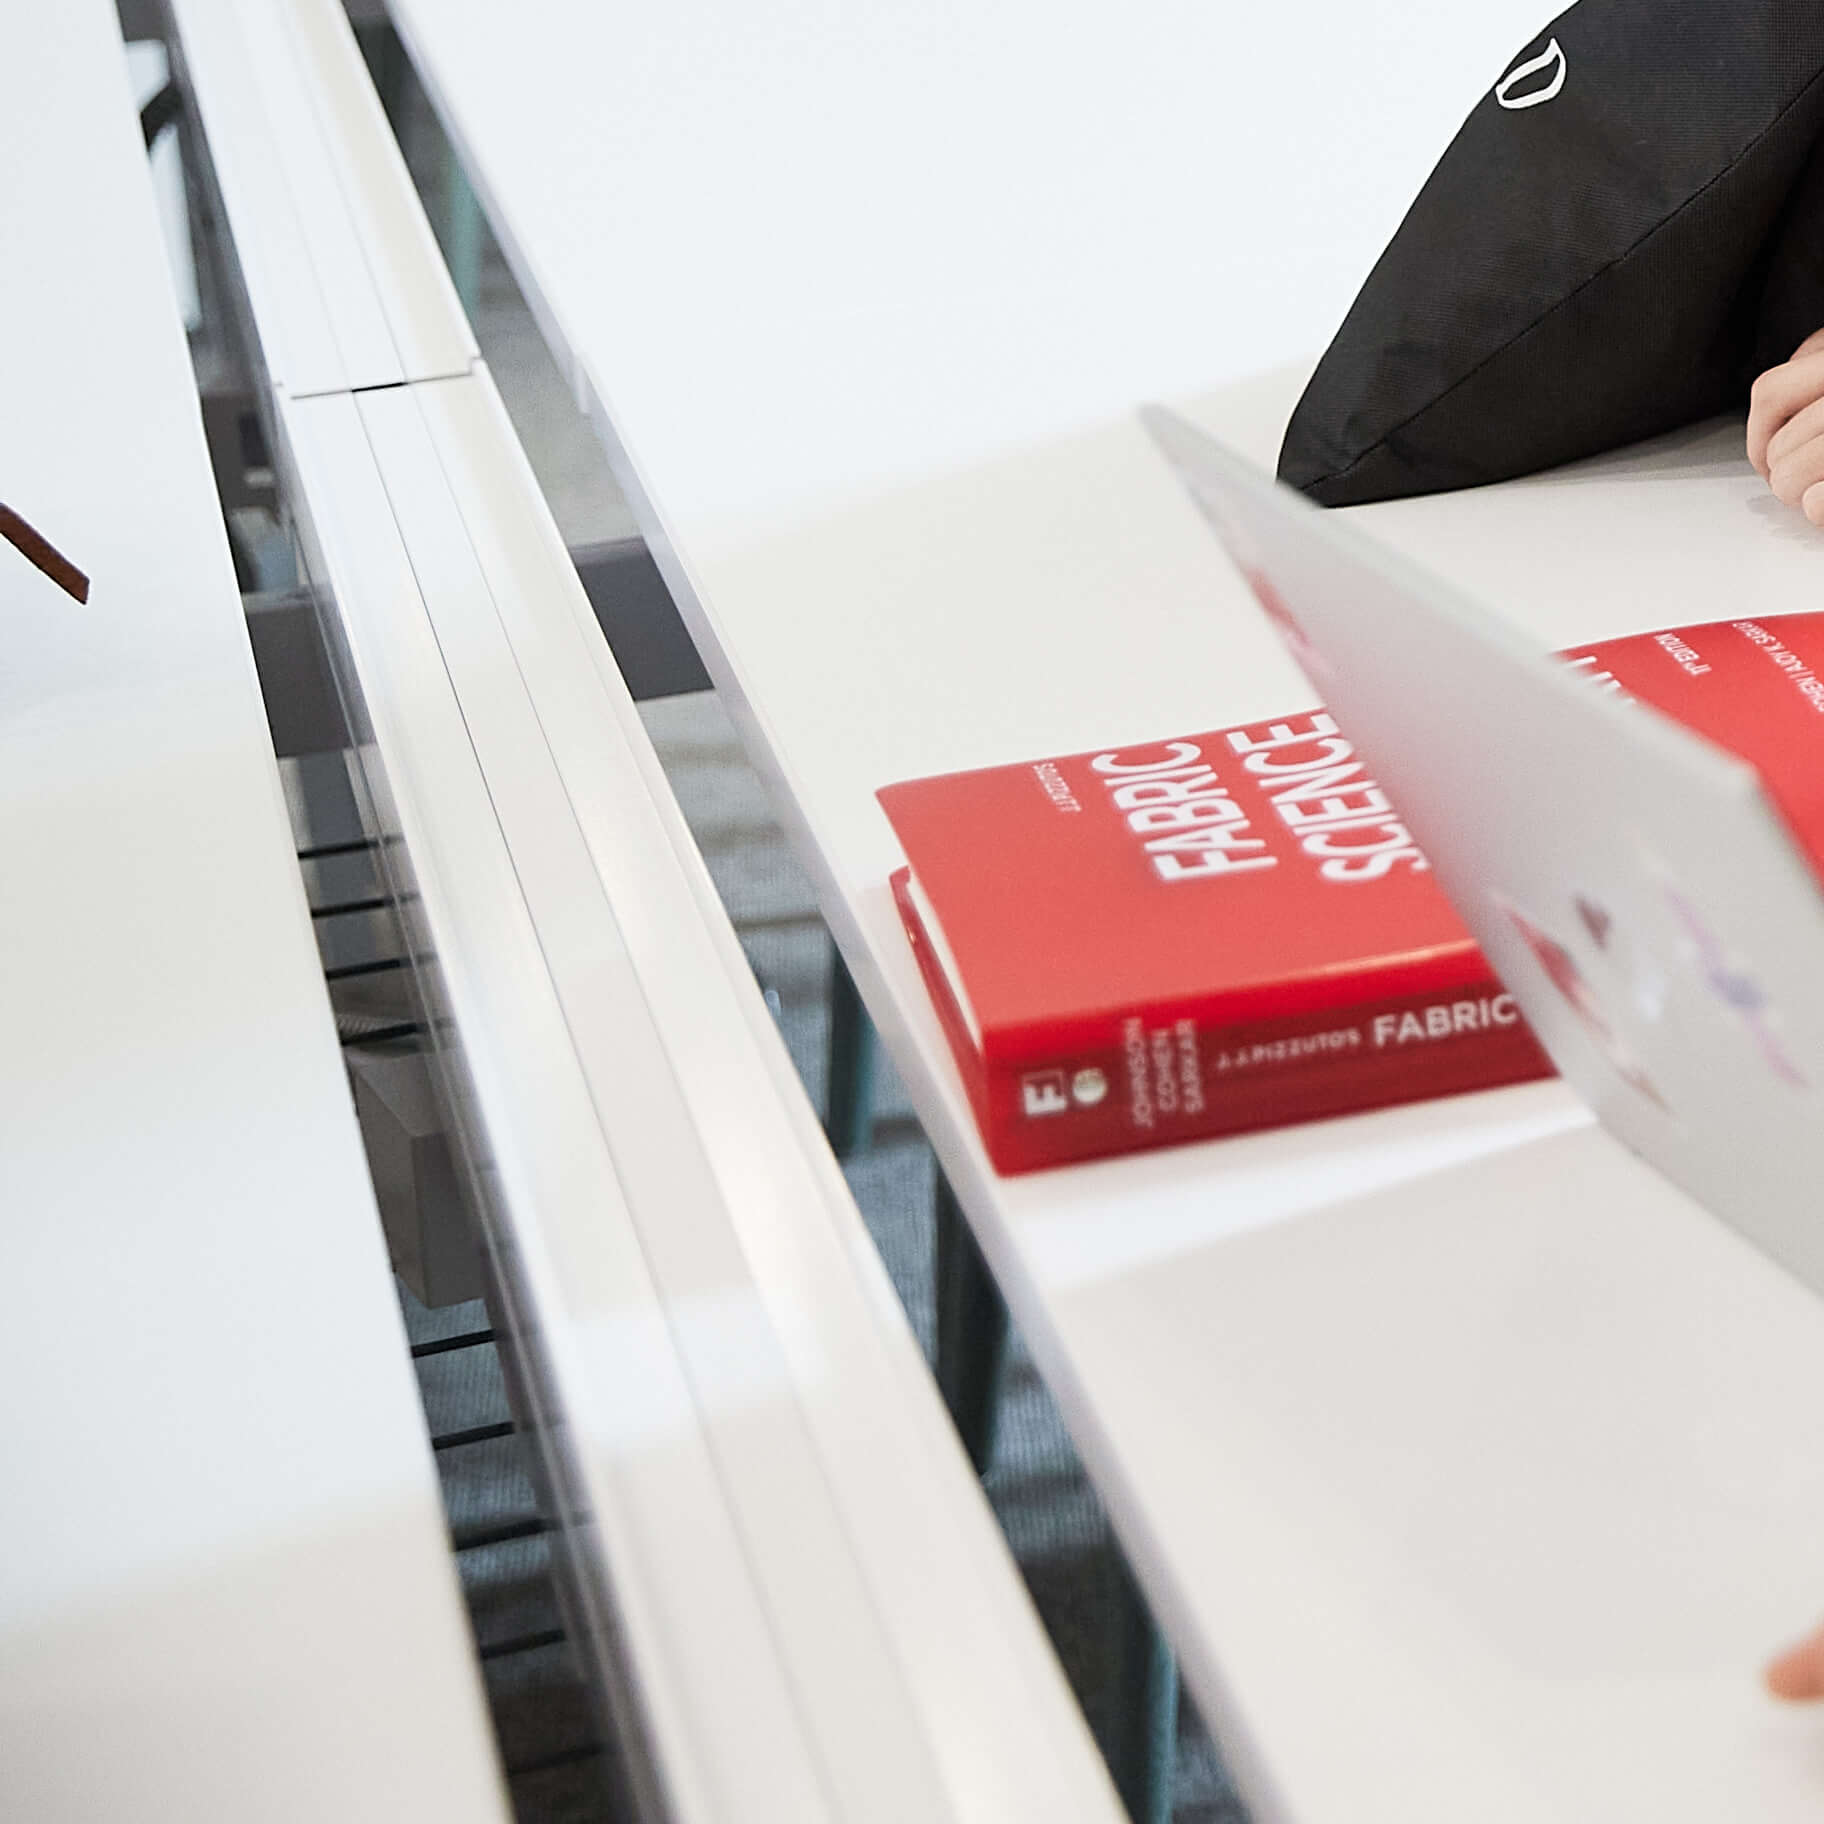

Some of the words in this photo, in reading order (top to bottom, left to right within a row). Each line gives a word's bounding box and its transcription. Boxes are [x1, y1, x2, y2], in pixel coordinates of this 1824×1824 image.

[1768, 651, 1808, 672] AJOY
[1091, 741, 1279, 882] FABRIC
[1226, 713, 1431, 884] SCIENCE
[1175, 1018, 1204, 1114] SARKAR
[1373, 993, 1517, 1048] FABRIC
[1124, 1017, 1154, 1128] JOHNSON
[1152, 1029, 1176, 1113] COHEN
